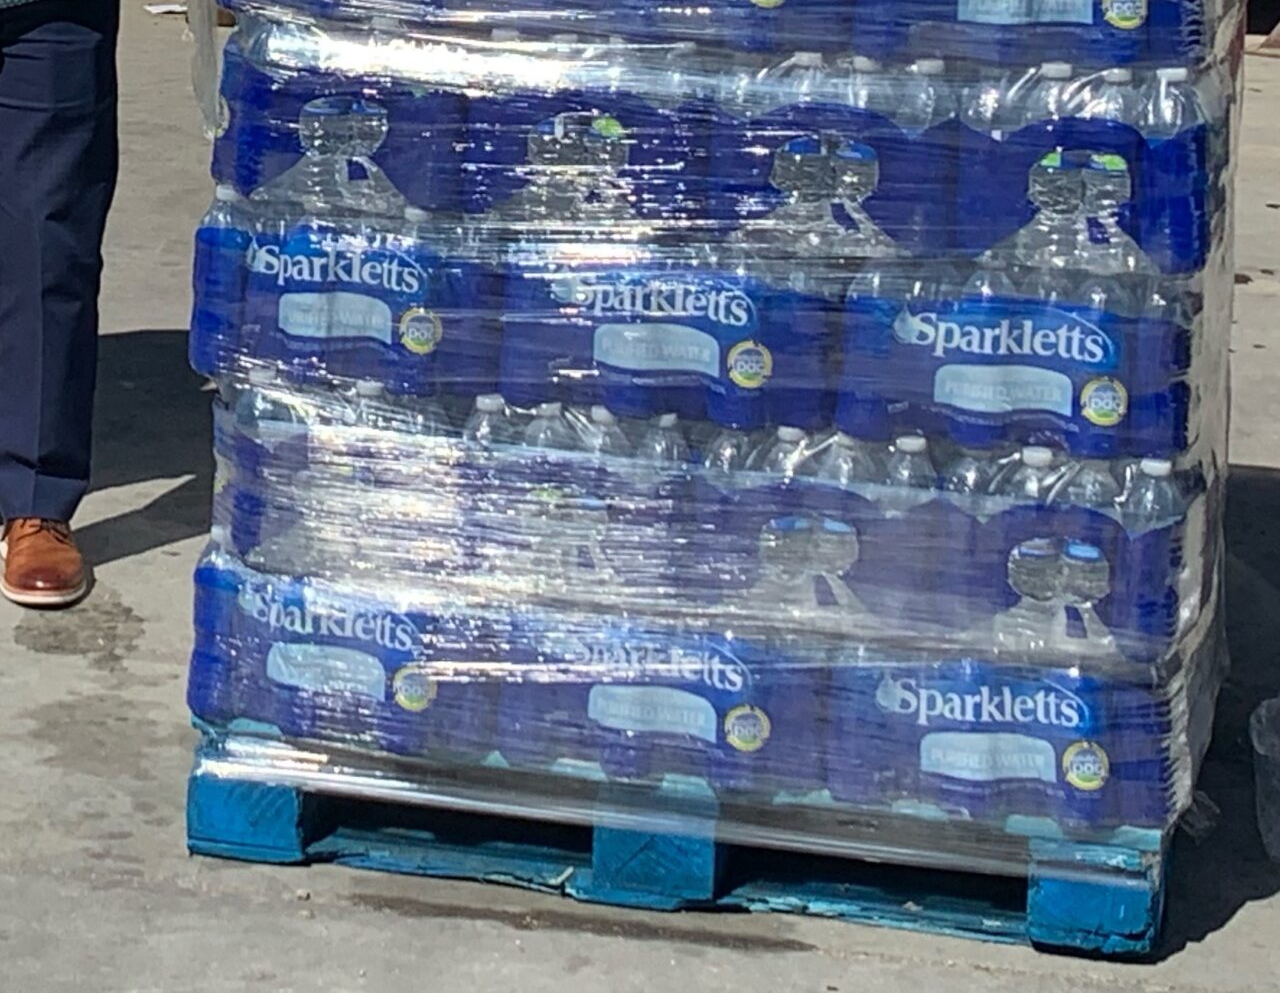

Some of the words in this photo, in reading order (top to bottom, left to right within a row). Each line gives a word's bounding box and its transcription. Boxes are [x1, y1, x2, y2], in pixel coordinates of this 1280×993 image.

[259, 245, 420, 293] Sparkletts
[575, 276, 748, 326] Sparkletts
[910, 312, 1104, 363] Sparkletts
[893, 679, 1081, 727] Sparkletts
